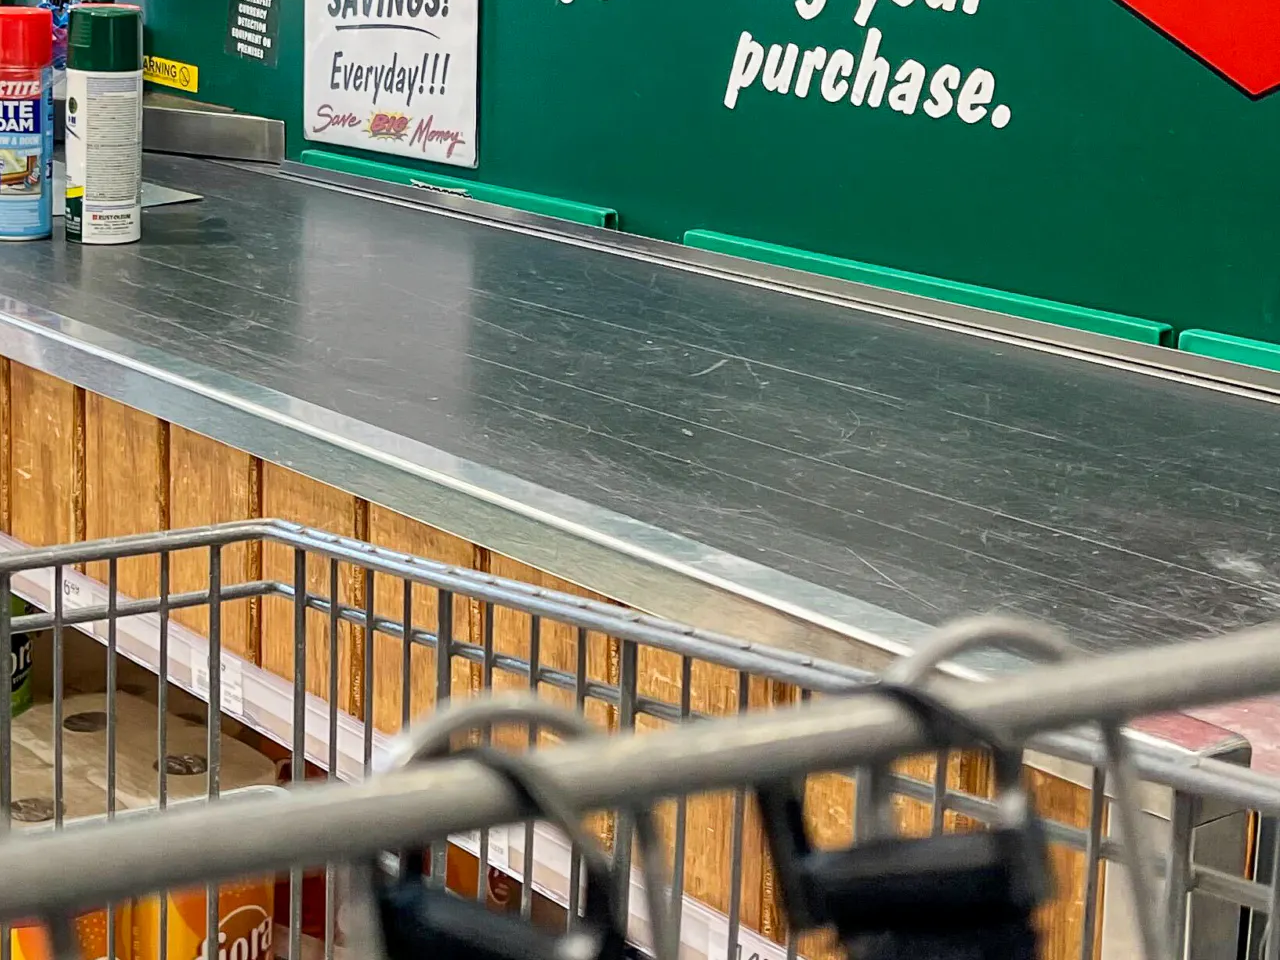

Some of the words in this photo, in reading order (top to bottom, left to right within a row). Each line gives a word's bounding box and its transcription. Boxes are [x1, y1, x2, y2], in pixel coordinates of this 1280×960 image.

[143, 59, 177, 78] ARNING
[330, 50, 451, 107] Everyday!!!
[724, 27, 1011, 129] purchase.
[313, 104, 362, 133] Save
[370, 113, 409, 133] BIG
[409, 115, 466, 158] Money
